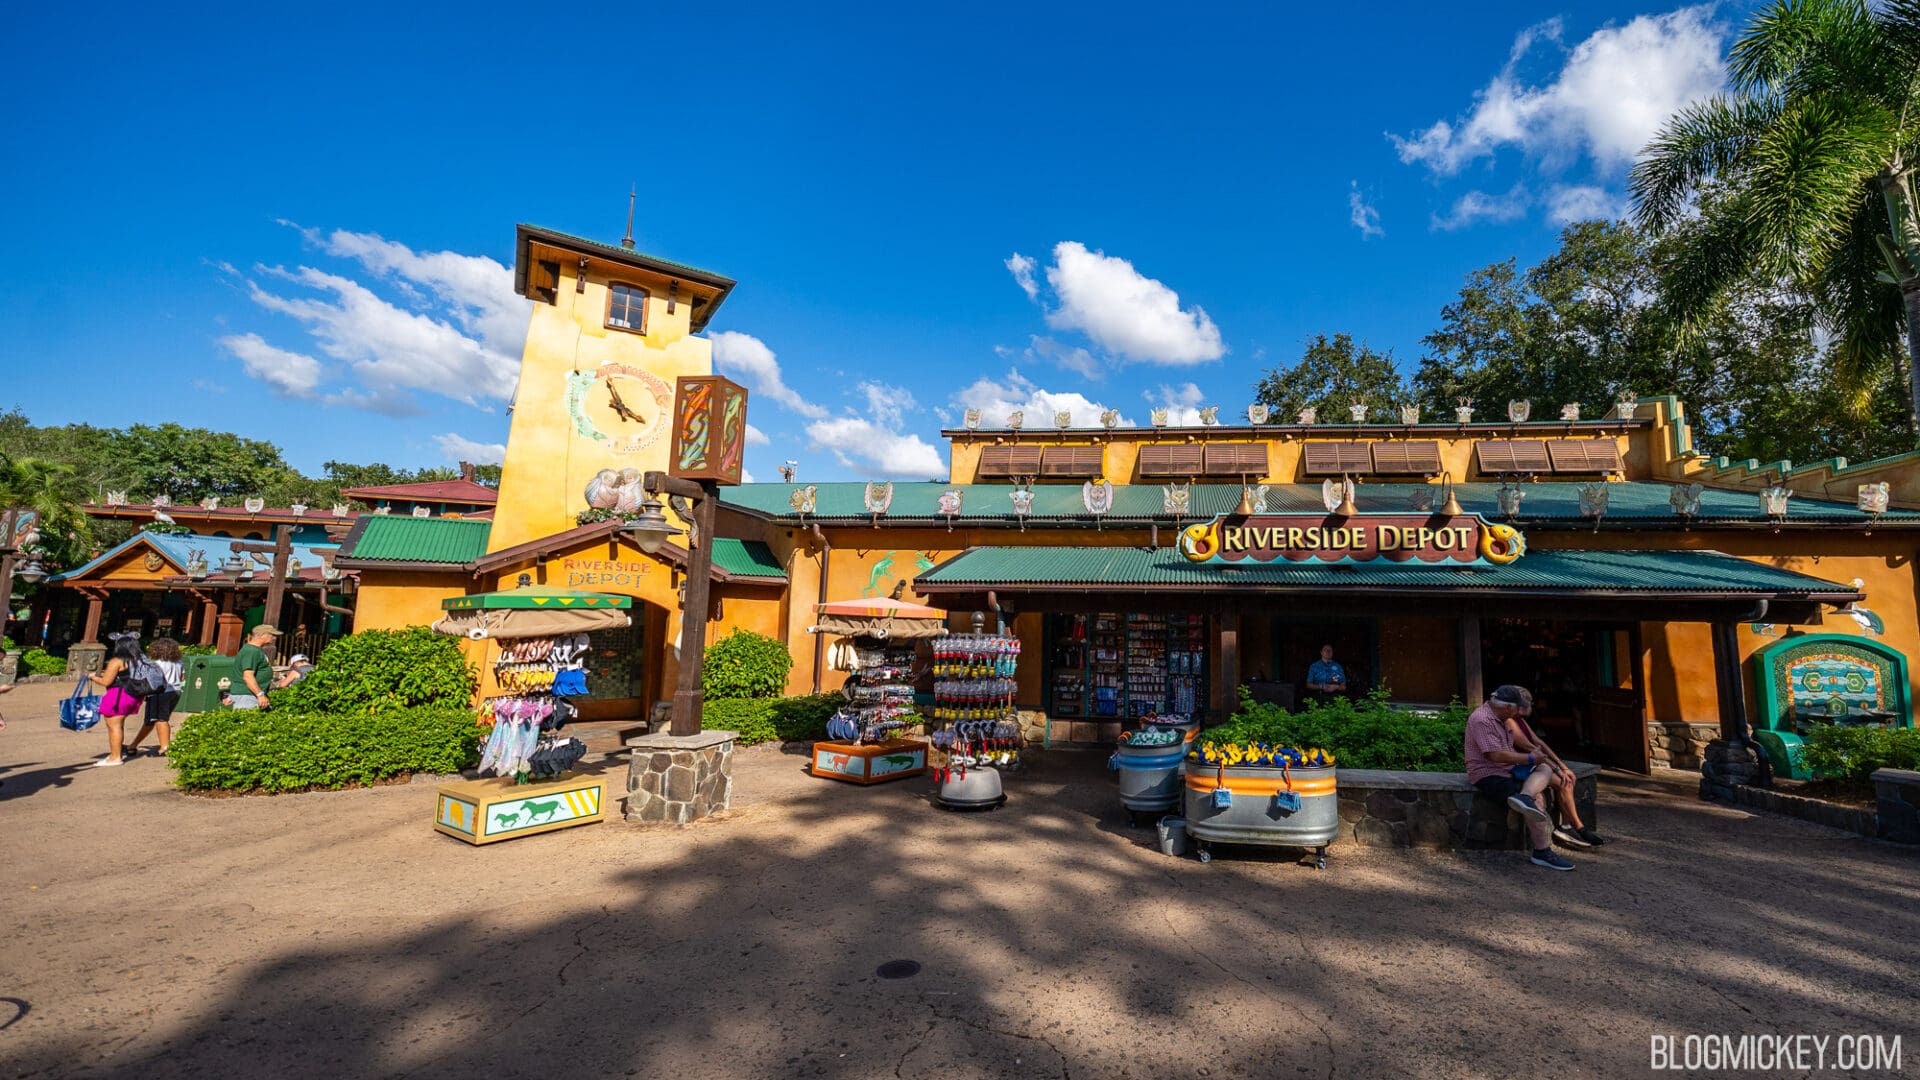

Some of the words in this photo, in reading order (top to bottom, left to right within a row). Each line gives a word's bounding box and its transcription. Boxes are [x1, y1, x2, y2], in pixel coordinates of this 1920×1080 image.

[1223, 526, 1368, 551] RIVERSIDE
[1377, 525, 1473, 551] DEPOT
[563, 558, 652, 574] RIVERSIDE
[568, 572, 645, 588] DEPOT
